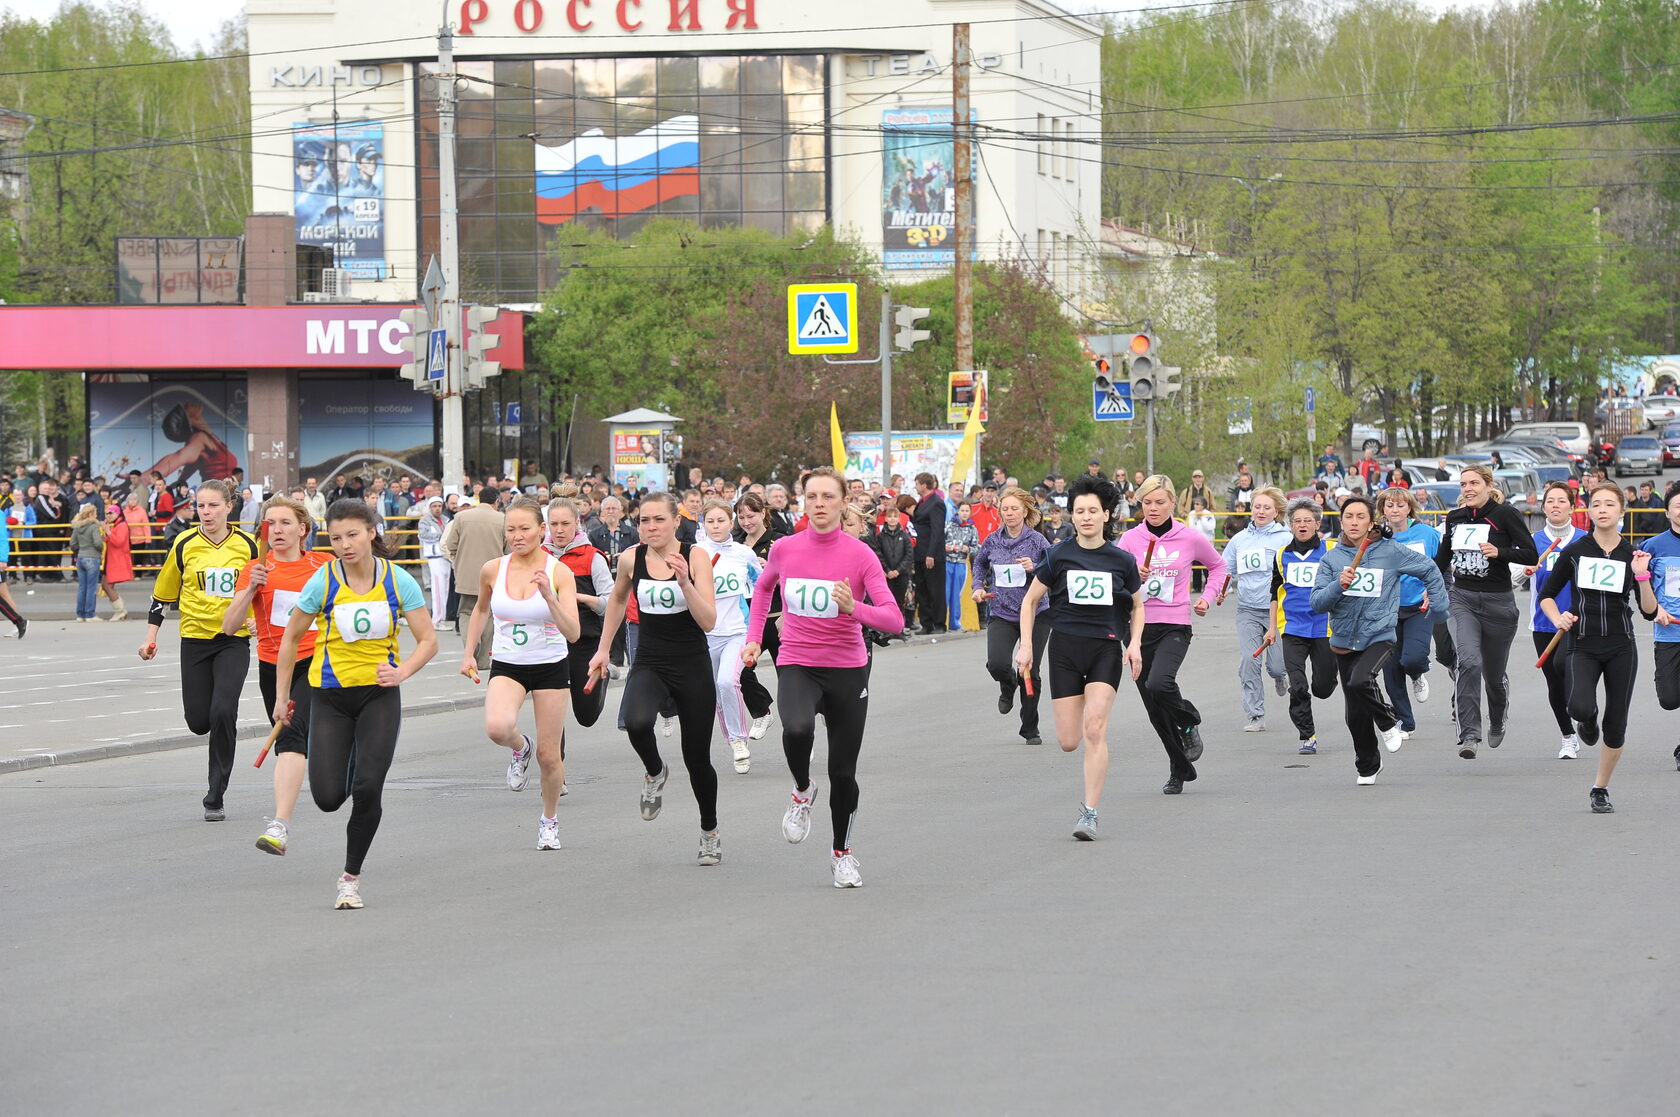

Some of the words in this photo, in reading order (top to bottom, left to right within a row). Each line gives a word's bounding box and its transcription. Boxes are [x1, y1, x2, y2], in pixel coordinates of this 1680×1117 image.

[458, 0, 759, 34] РОССИЯ
[860, 52, 1003, 76] ТЕАР
[271, 65, 382, 87] КИНО
[364, 201, 377, 211] 19
[306, 319, 410, 354] МТС
[326, 406, 369, 415] Оператор
[374, 405, 413, 414] свободы
[1464, 528, 1476, 545] 7
[1242, 553, 1261, 569] 16
[207, 572, 234, 593] 18
[714, 573, 740, 595] 26
[1003, 568, 1012, 584] 1
[1293, 566, 1313, 583] 15
[1349, 571, 1375, 592] 23
[1588, 563, 1617, 587] 12
[645, 585, 676, 609] 19
[795, 584, 829, 612] 10
[1074, 575, 1105, 599] 25
[1147, 580, 1161, 597] 9
[353, 607, 371, 634] 6
[512, 623, 529, 646] 5
